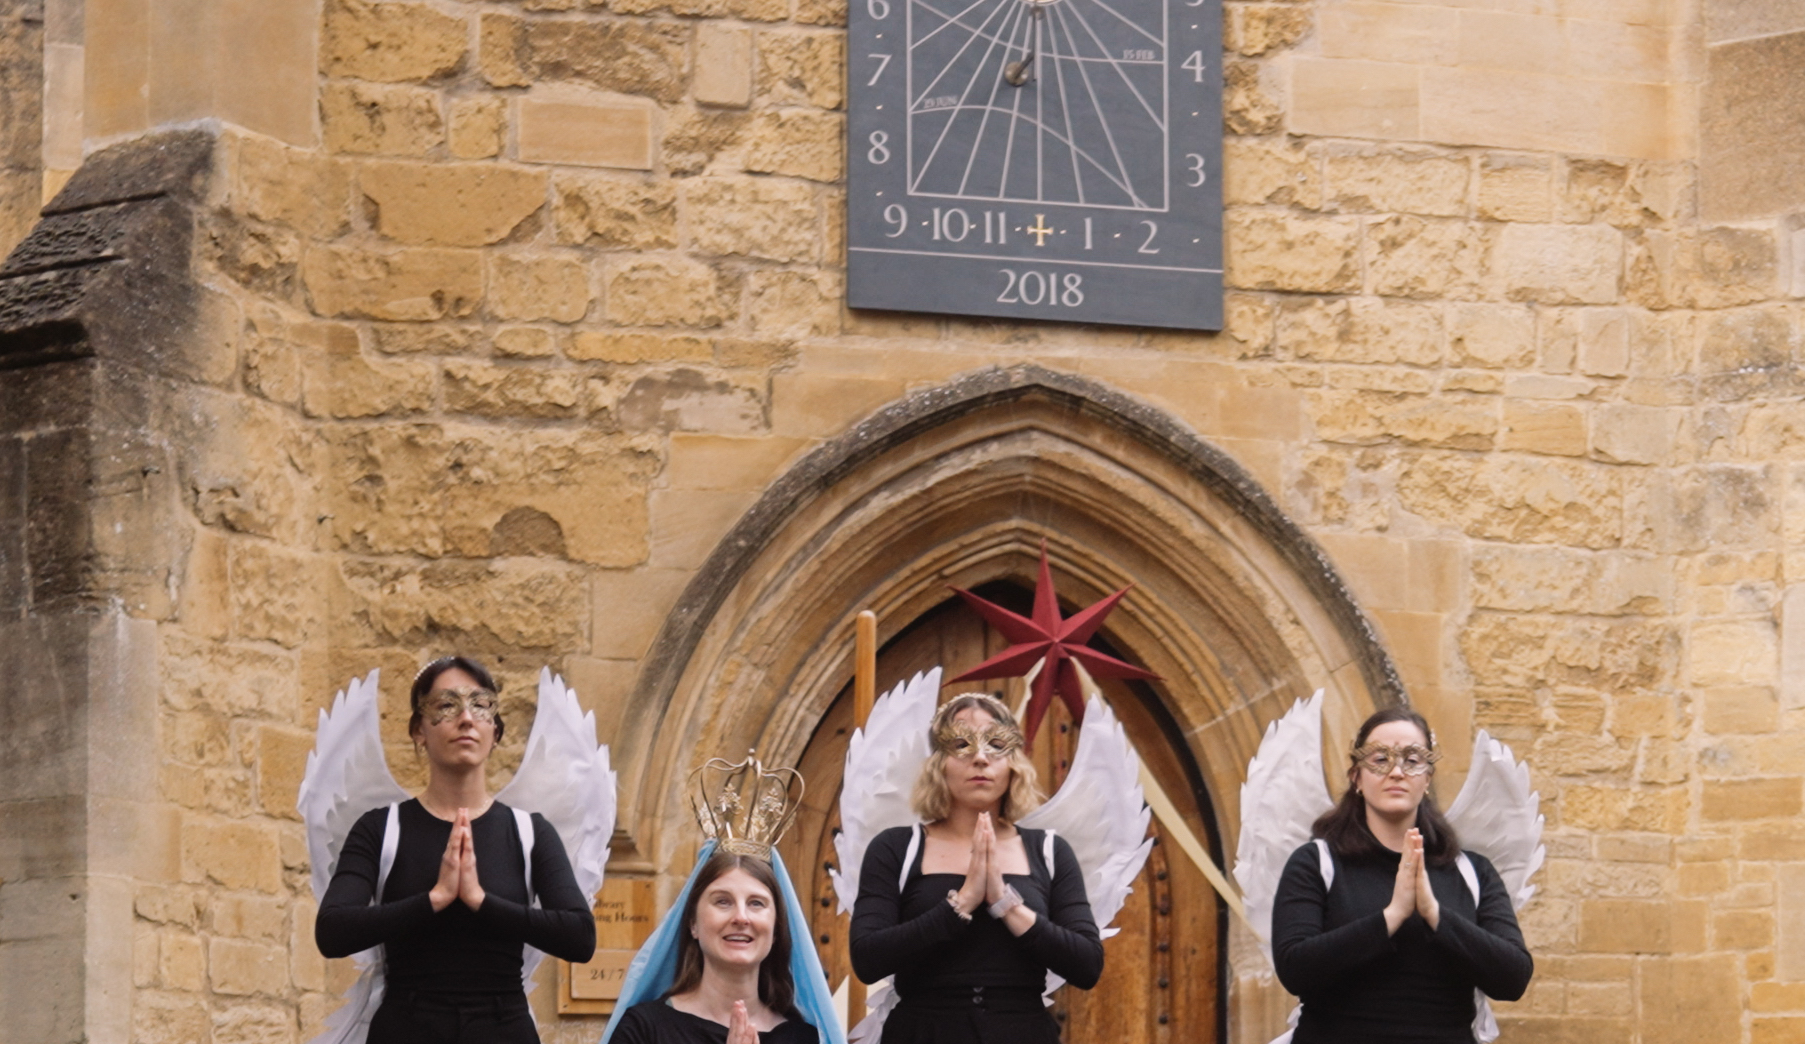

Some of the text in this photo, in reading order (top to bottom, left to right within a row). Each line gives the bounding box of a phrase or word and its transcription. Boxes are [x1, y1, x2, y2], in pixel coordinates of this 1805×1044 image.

[867, 54, 892, 87] 7
[1180, 50, 1206, 83] 4
[936, 95, 958, 108] JUN
[867, 130, 891, 165] 8
[1185, 153, 1206, 188] 3
[883, 203, 1160, 255] 9 10 11 1 2
[996, 268, 1085, 308] 2018
[594, 897, 626, 910] ibrary
[614, 910, 650, 923] Hours
